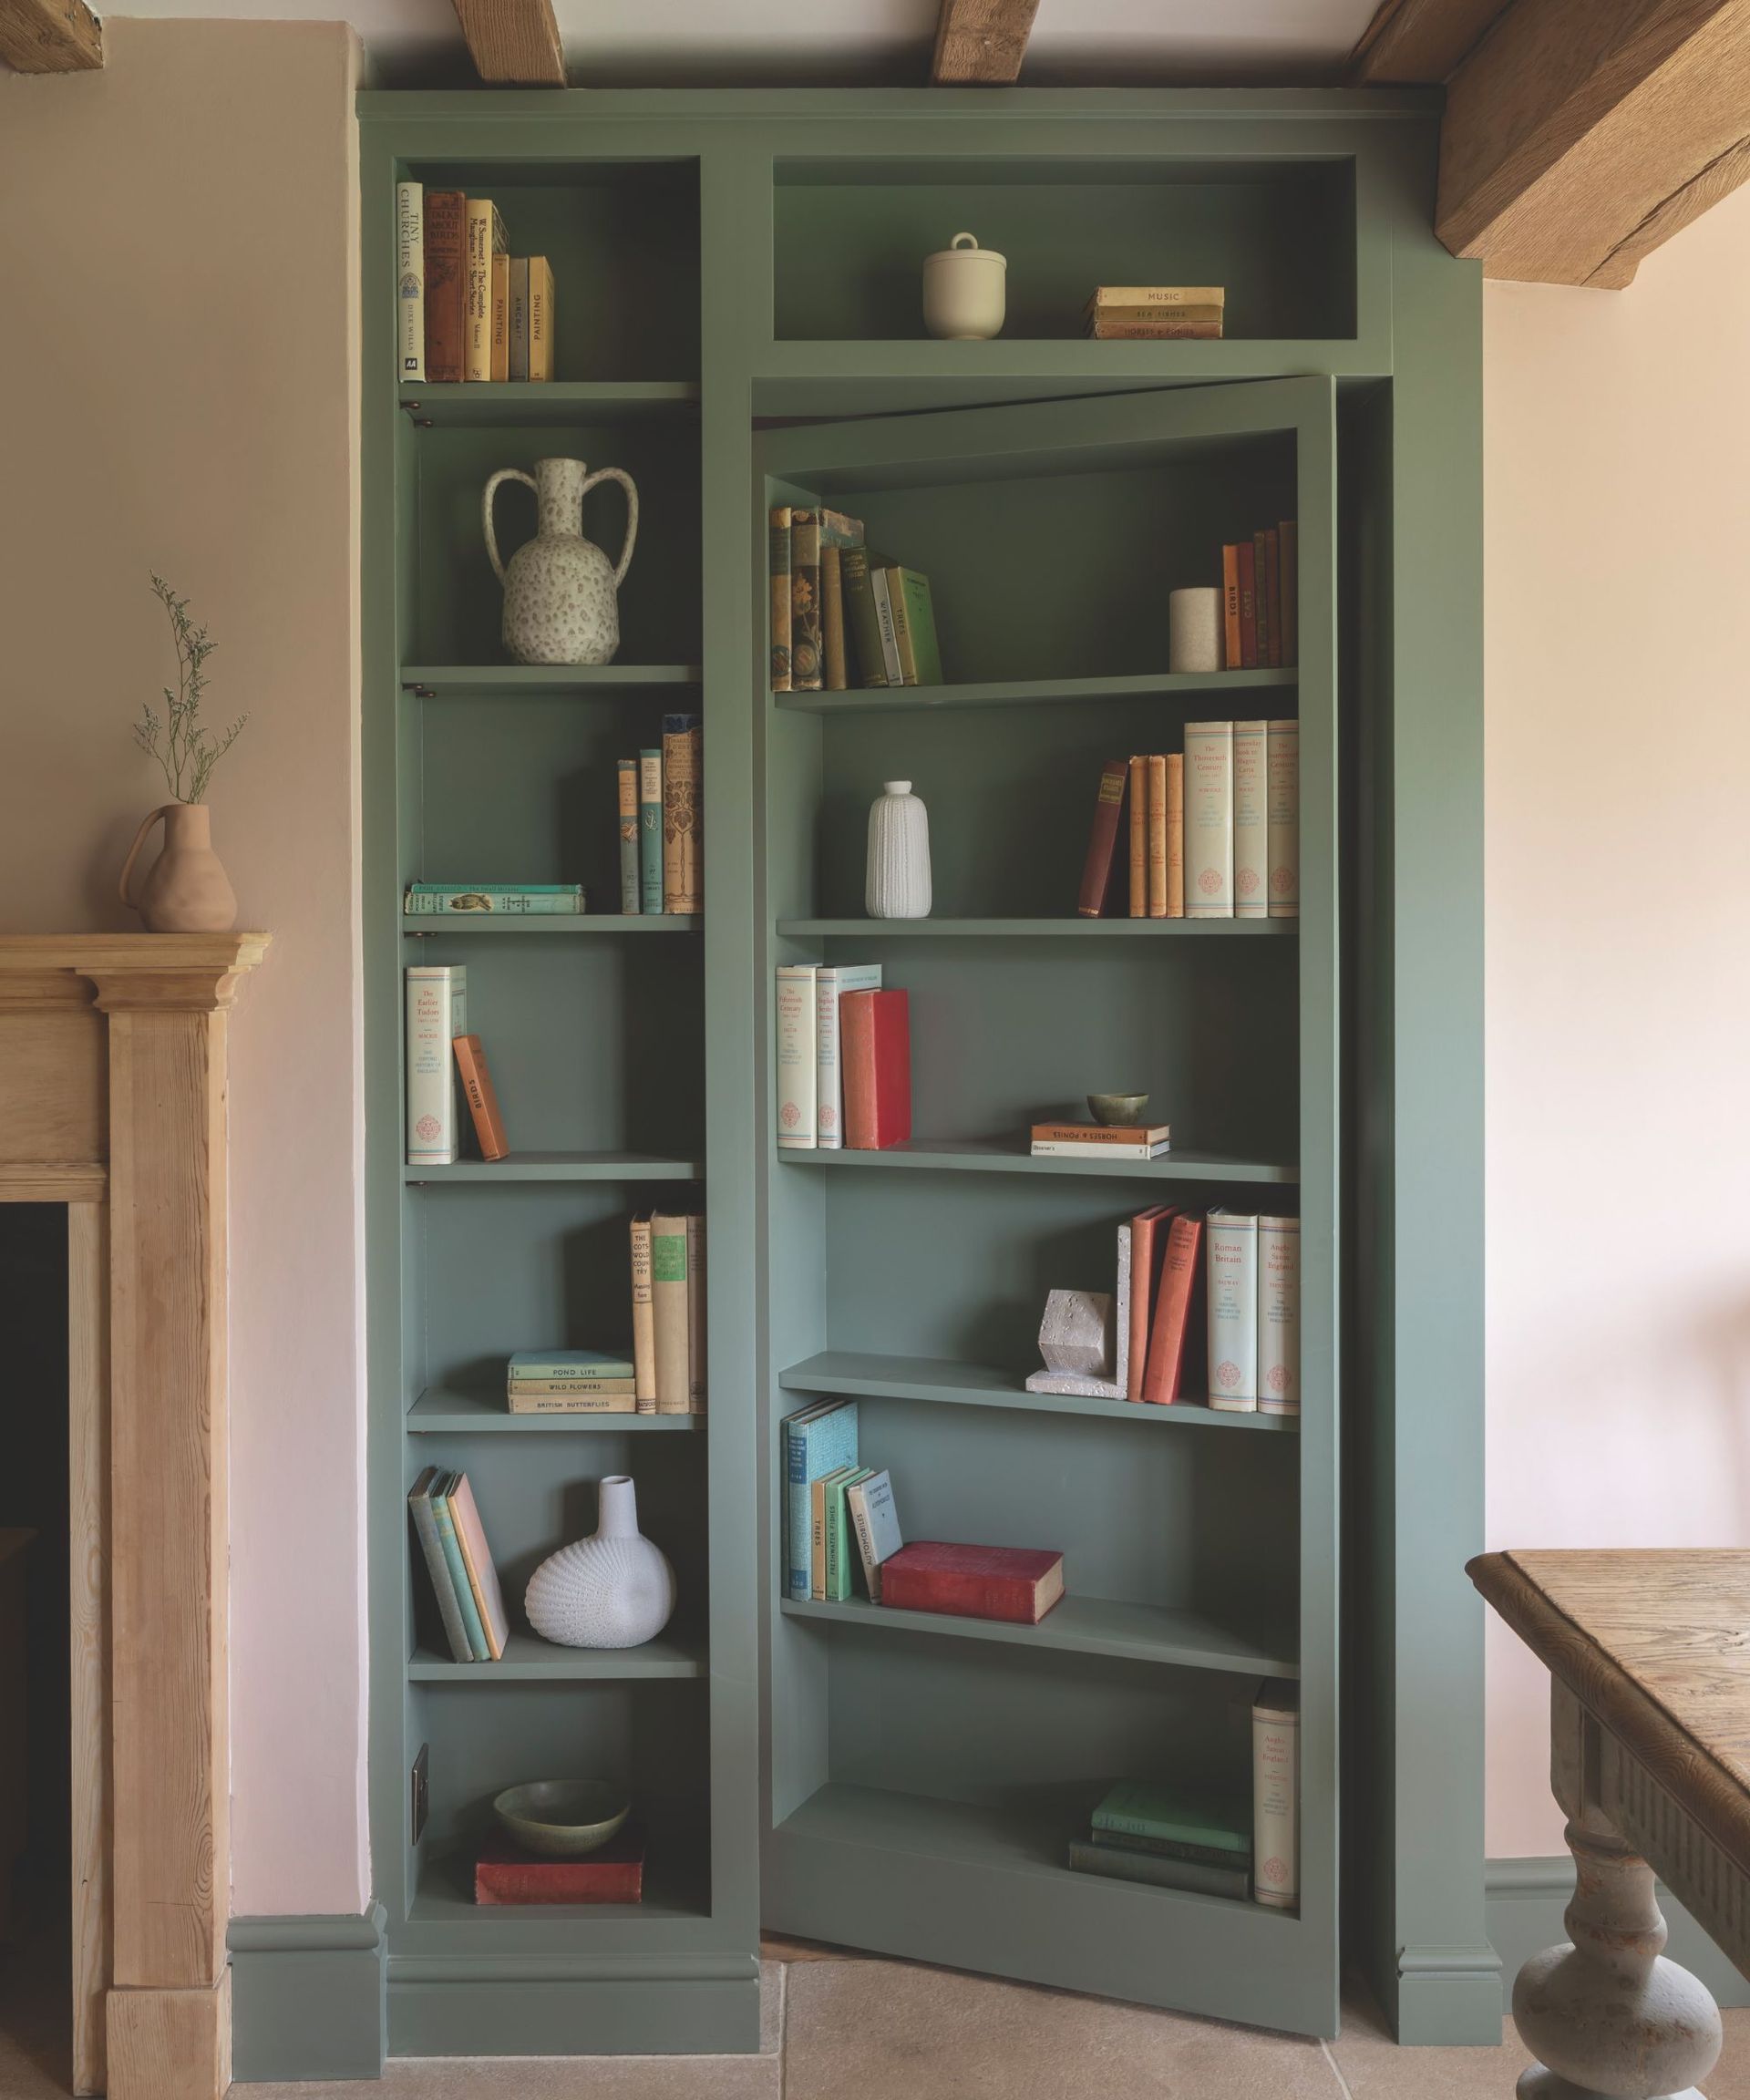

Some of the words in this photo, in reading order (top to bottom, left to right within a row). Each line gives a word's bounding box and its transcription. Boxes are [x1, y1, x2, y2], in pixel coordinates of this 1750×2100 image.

[401, 189, 410, 268] CHURCHES
[410, 212, 419, 244] TINY
[468, 218, 477, 253] Maugham
[479, 270, 487, 283] The
[478, 284, 487, 319] Complete
[1148, 293, 1179, 301] MUSIC
[1229, 586, 1238, 617] BIRDS
[896, 607, 906, 635] TREES
[468, 1078, 482, 1109] BIRDS
[1053, 1131, 1080, 1139] PONIES
[1214, 1242, 1241, 1252] Roman
[1215, 1254, 1241, 1263] Britain
[1268, 1261, 1294, 1271] England
[857, 1513, 873, 1566] AUTOMOBILES
[1262, 1754, 1289, 1763] England
